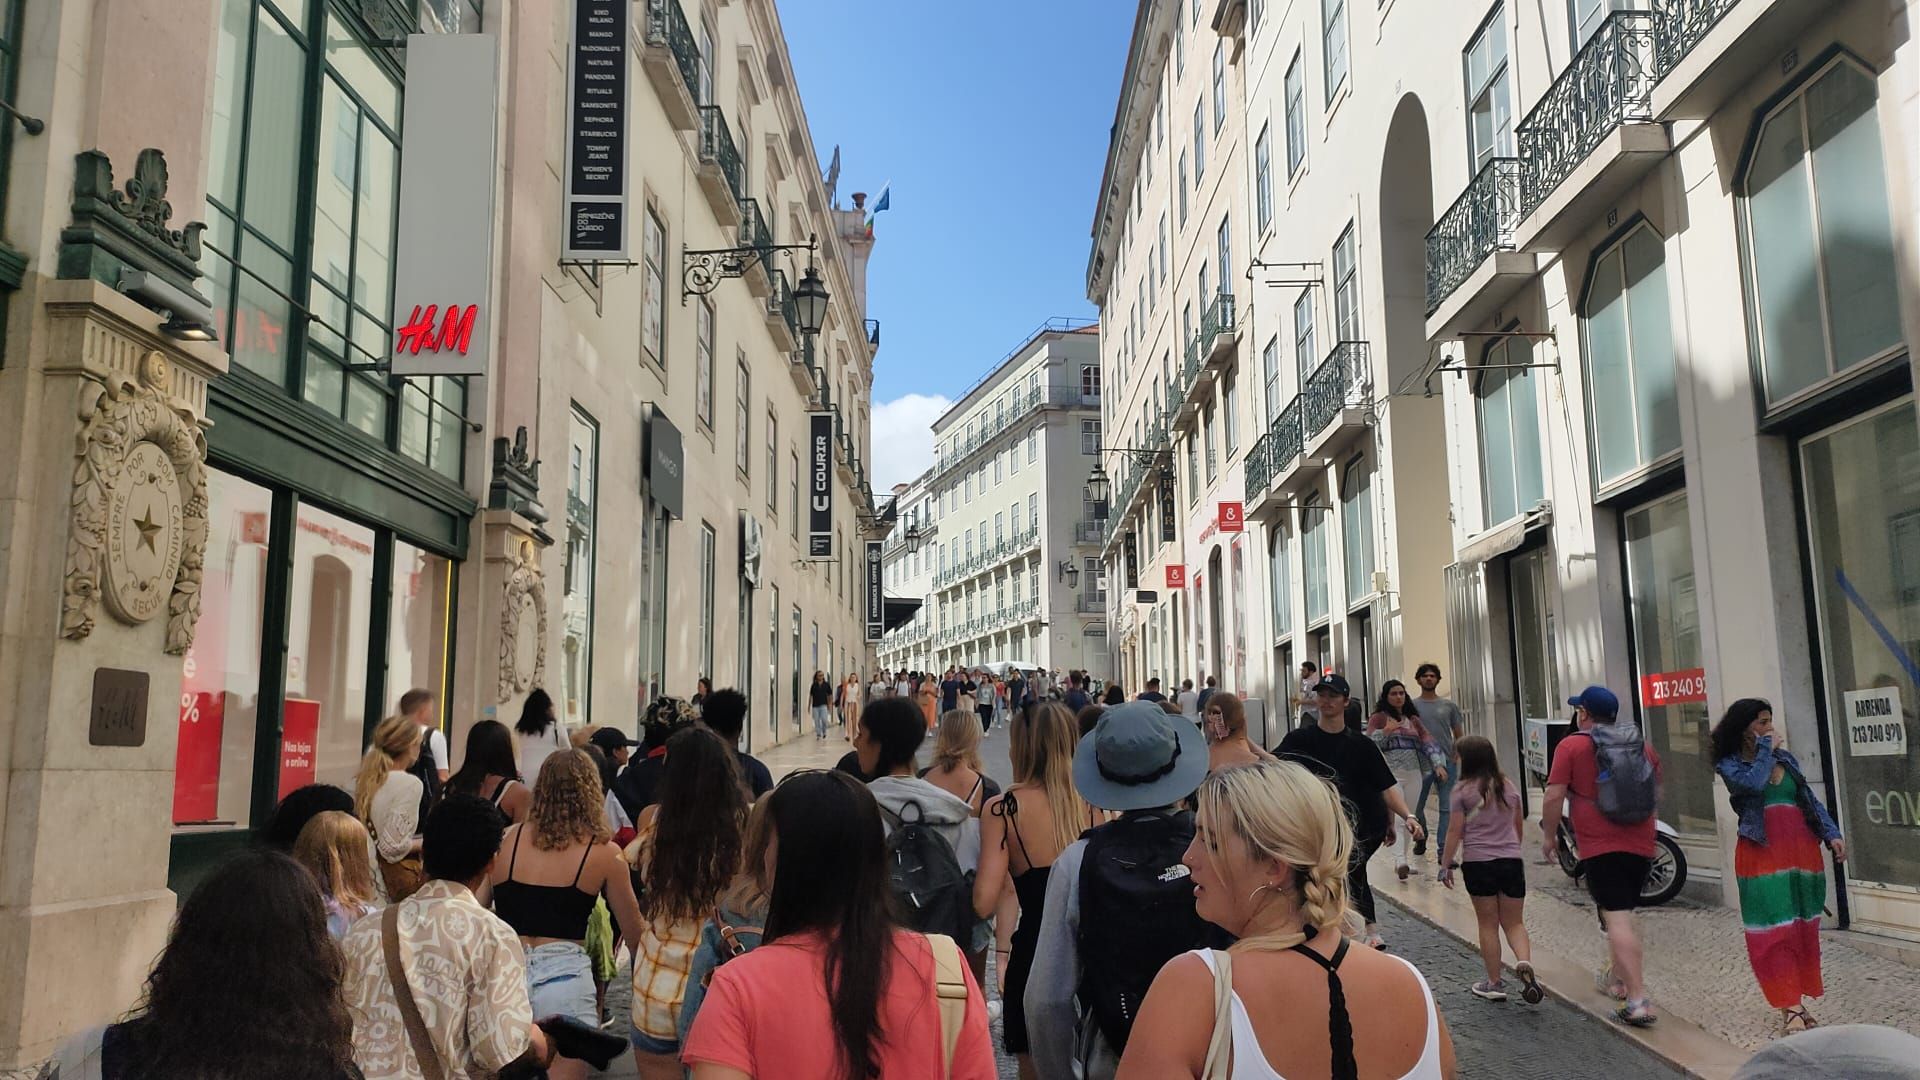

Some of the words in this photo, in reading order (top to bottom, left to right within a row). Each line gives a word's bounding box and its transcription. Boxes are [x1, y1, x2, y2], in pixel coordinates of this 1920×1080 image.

[397, 304, 479, 355] H&M
[126, 452, 145, 478] POR
[156, 455, 175, 487] BOM
[816, 435, 827, 492] COURIR
[1163, 480, 1174, 525] HAIR
[111, 494, 126, 563] SEMPRE
[166, 504, 181, 580] CAMINHO
[1127, 538, 1137, 577] HAIR
[120, 582, 130, 596] E
[131, 591, 162, 615] SEGUE
[1653, 681, 1670, 699] 213
[1672, 678, 1694, 697] 240
[1855, 698, 1892, 717] ARRENDA
[1852, 725, 1868, 743] 213
[1868, 724, 1884, 742] 240
[285, 741, 296, 753] Nas
[290, 756, 309, 768] online
